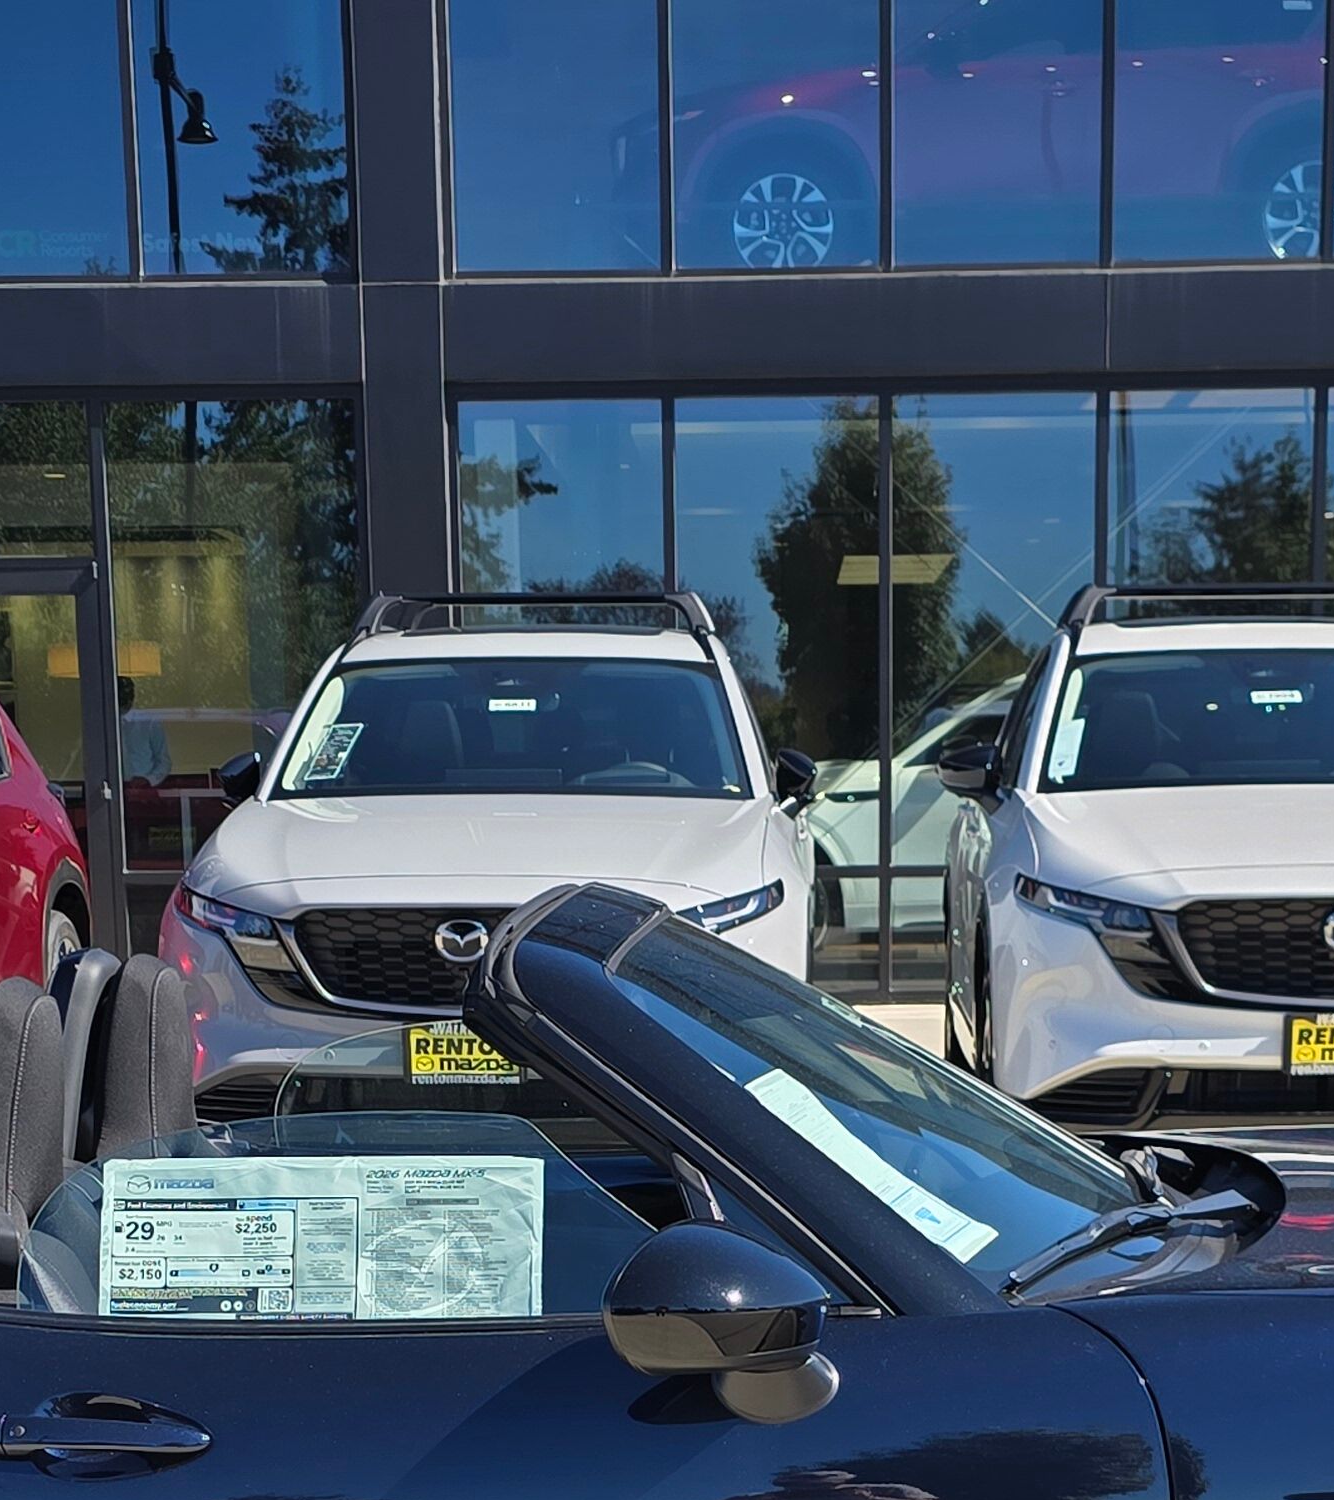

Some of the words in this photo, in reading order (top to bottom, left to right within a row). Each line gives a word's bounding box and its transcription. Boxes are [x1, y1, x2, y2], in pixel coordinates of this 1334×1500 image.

[38, 230, 109, 242] Consumer
[143, 232, 210, 253] Saest
[40, 243, 94, 258] Reports
[415, 1038, 495, 1056] RENTO
[439, 1058, 514, 1071] mazda
[412, 1074, 521, 1085] rentonmazda.com
[366, 1169, 401, 1179] 2026
[452, 1168, 486, 1178] MX-5
[154, 1178, 215, 1189] mazda
[126, 1221, 155, 1240] 29
[235, 1222, 277, 1235] $2,250
[118, 1268, 162, 1280] $2,150
